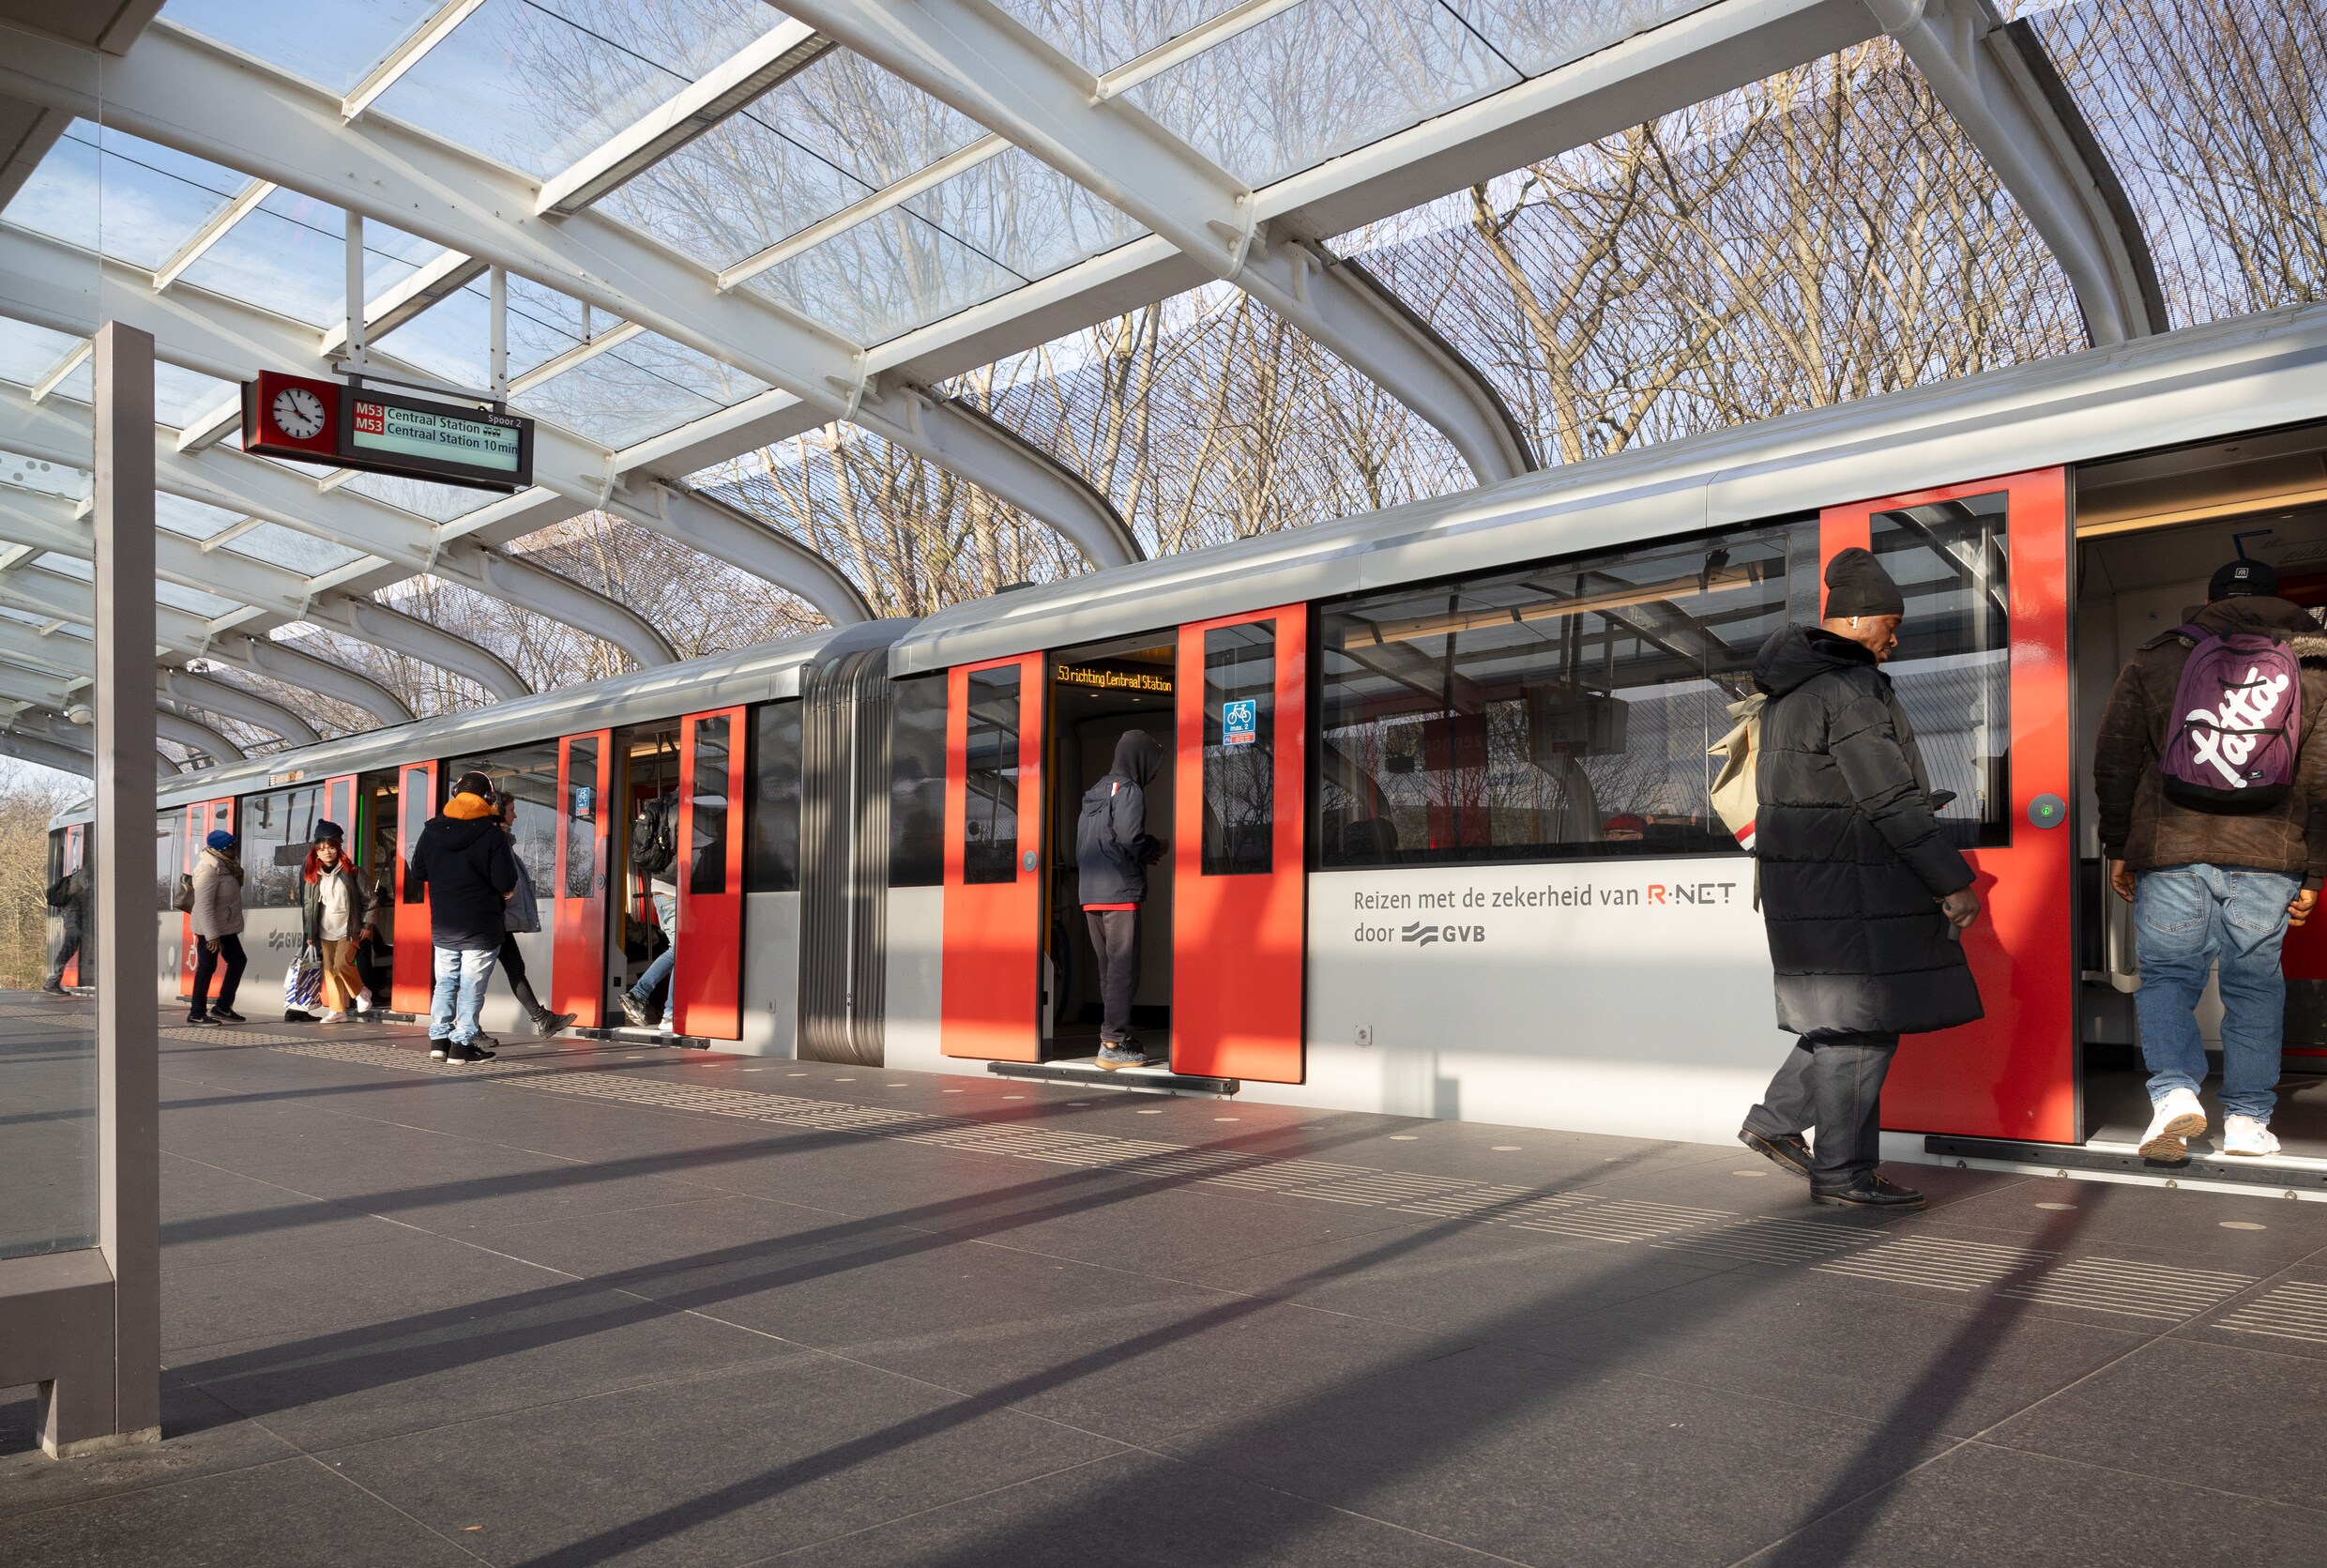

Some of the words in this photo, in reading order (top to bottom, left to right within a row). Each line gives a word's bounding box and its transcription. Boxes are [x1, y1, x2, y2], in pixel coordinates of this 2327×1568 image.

[356, 402, 383, 417] M53
[388, 407, 436, 426] Centraal
[440, 416, 479, 434] Station
[488, 414, 513, 427] Spoor
[516, 419, 522, 428] 2
[356, 417, 383, 432] M53
[387, 422, 435, 441] Centraal
[439, 431, 479, 449] Station
[1071, 668, 1104, 687] richting
[1106, 671, 1140, 688] Centraal
[1142, 675, 1172, 692] Station
[1354, 891, 1411, 910] Reizen
[1418, 890, 1455, 908] met
[1462, 886, 1486, 908] de
[1491, 884, 1592, 908] zekerheid
[1600, 888, 1639, 906] van
[284, 932, 303, 948] GVB
[1354, 922, 1394, 942] door
[1442, 924, 1485, 943] GVB
